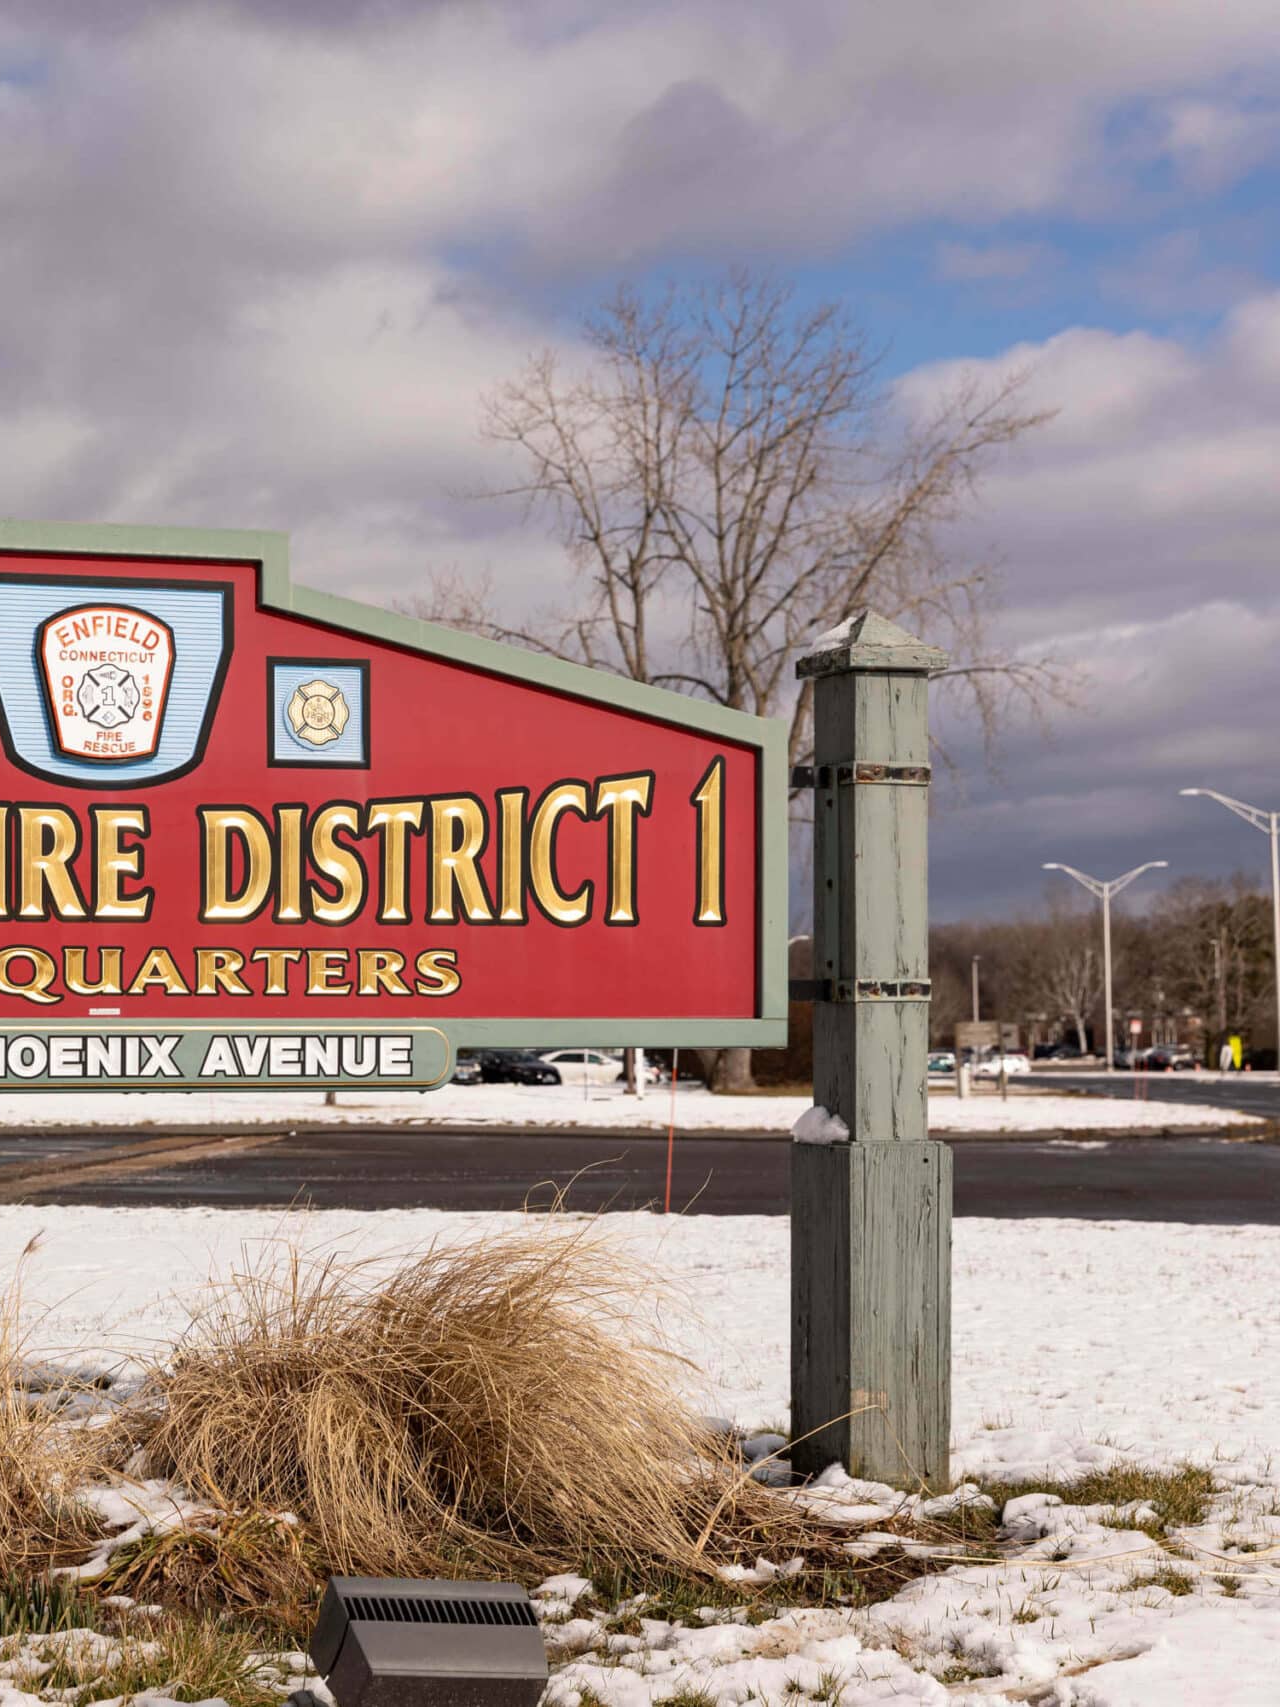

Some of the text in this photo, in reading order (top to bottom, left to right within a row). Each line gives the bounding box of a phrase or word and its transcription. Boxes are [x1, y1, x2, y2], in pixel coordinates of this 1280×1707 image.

[54, 615, 160, 650] ENFIELD
[59, 650, 156, 664] CONNECTICUT
[100, 686, 116, 706] 1
[83, 740, 136, 753] RESCUE
[96, 731, 123, 742] FIRE
[197, 768, 655, 928] DISTRICT
[689, 754, 728, 926] 1
[200, 1035, 413, 1078] AVENUE
